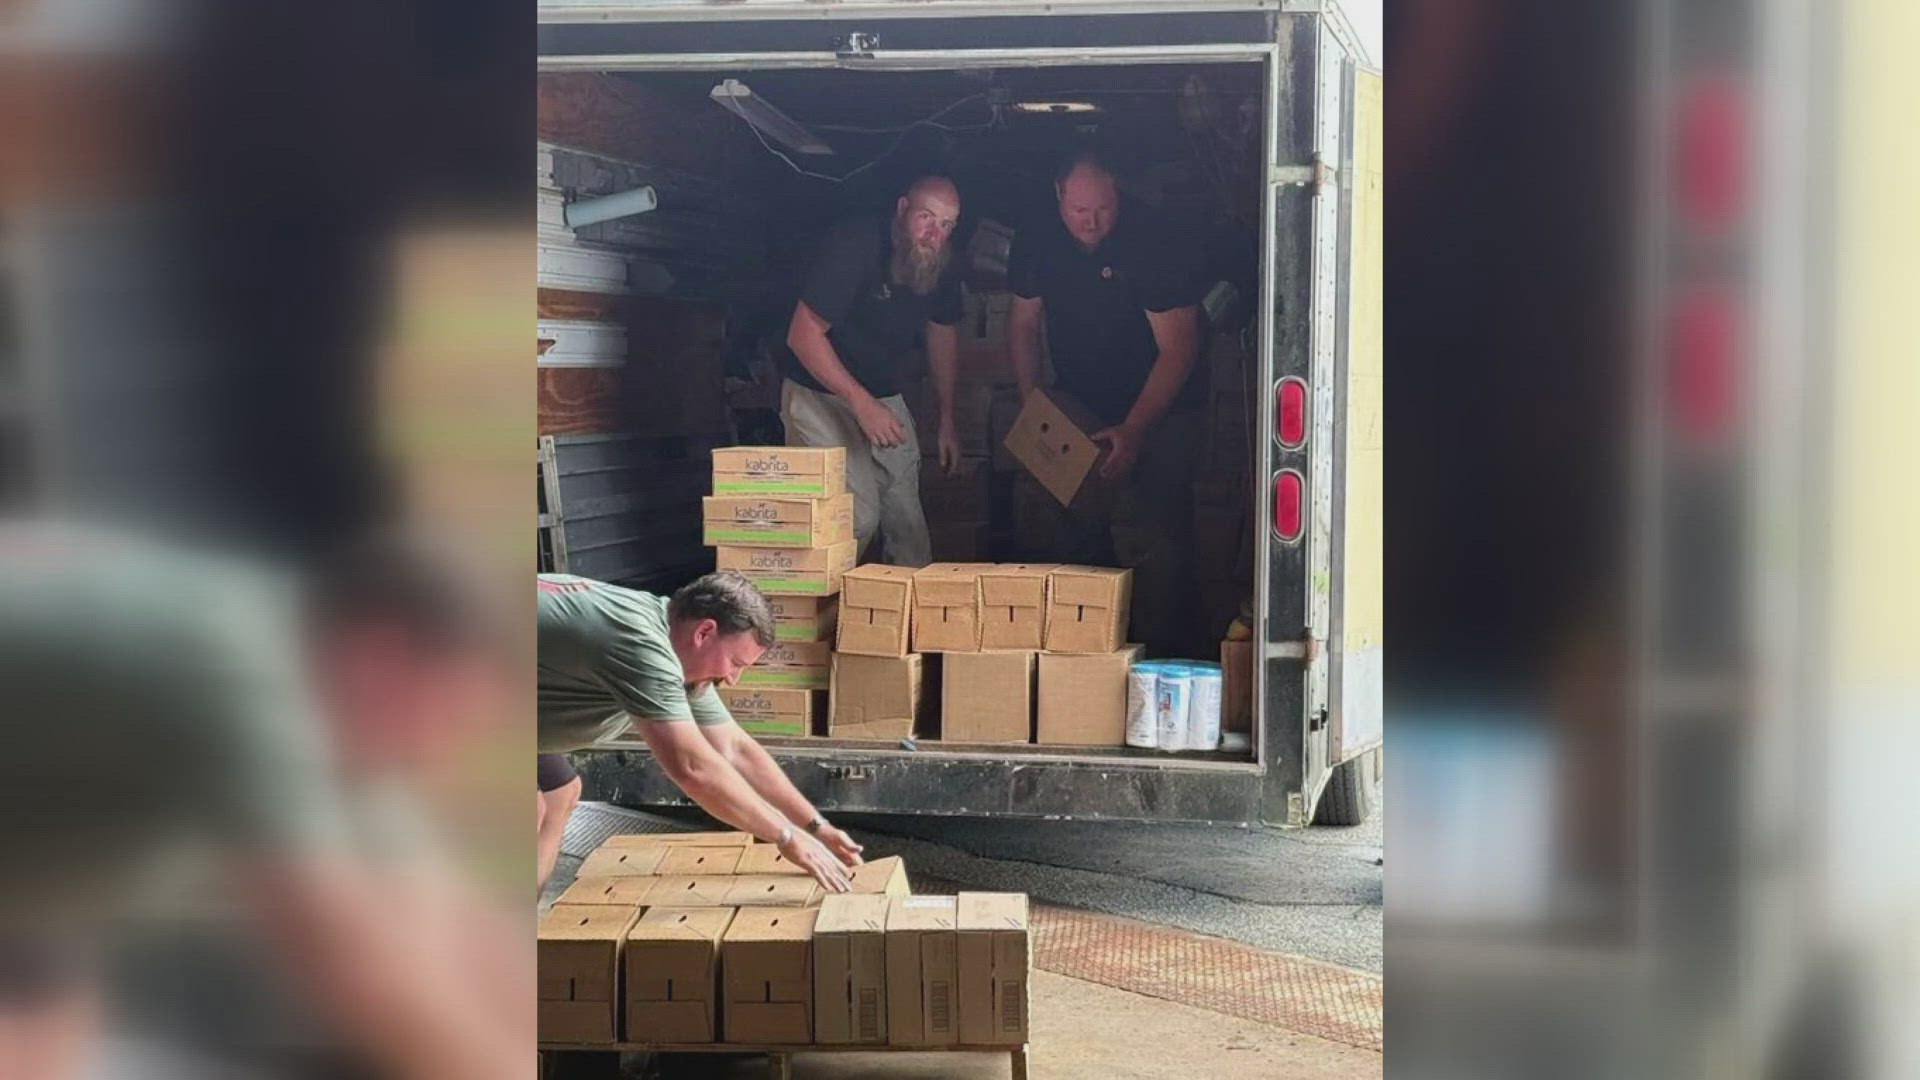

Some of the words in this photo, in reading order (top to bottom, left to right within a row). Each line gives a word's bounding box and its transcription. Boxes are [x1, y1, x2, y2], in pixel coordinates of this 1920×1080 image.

[745, 457, 789, 472] kabrita
[735, 507, 778, 520] kabrita
[751, 555, 793, 568] kabrita
[759, 649, 795, 661] abrita
[730, 697, 772, 710] kabrita
